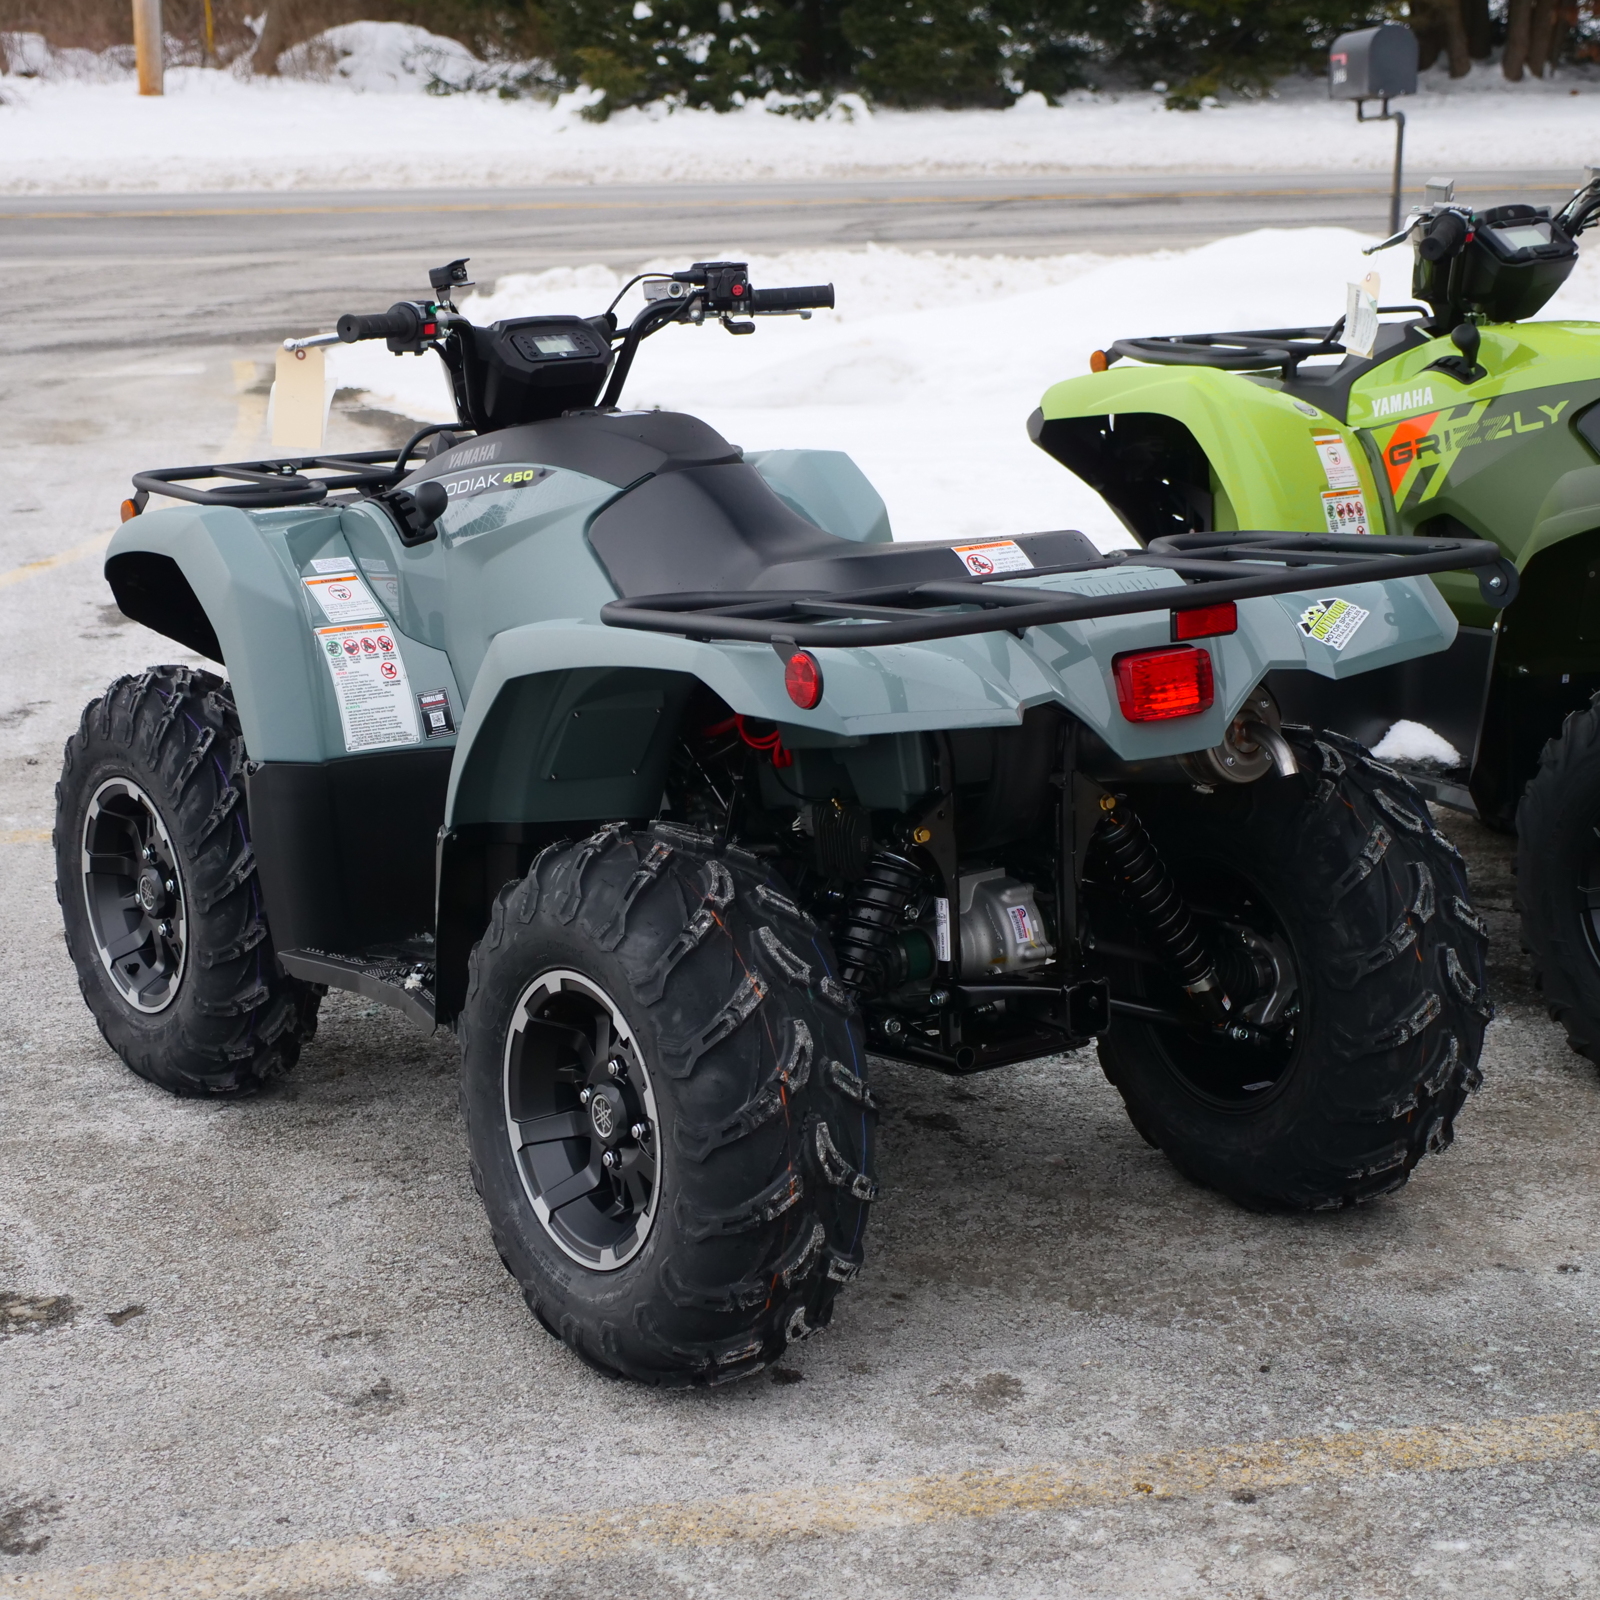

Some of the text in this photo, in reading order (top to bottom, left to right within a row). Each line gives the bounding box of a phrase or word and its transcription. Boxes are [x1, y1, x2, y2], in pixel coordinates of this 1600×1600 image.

[1371, 386, 1434, 418] YAMAHA
[1388, 400, 1570, 467] GRIZZLY
[448, 444, 496, 468] YAMAHA
[444, 470, 533, 497] ODIAK 450
[1070, 577, 1159, 597] YAMAHA
[1312, 601, 1349, 639] OUTDOOR
[1324, 624, 1341, 643] MOTOR
[1340, 606, 1357, 624] SPORTS
[1335, 623, 1351, 640] TRAILER
[1349, 610, 1361, 623] SALES
